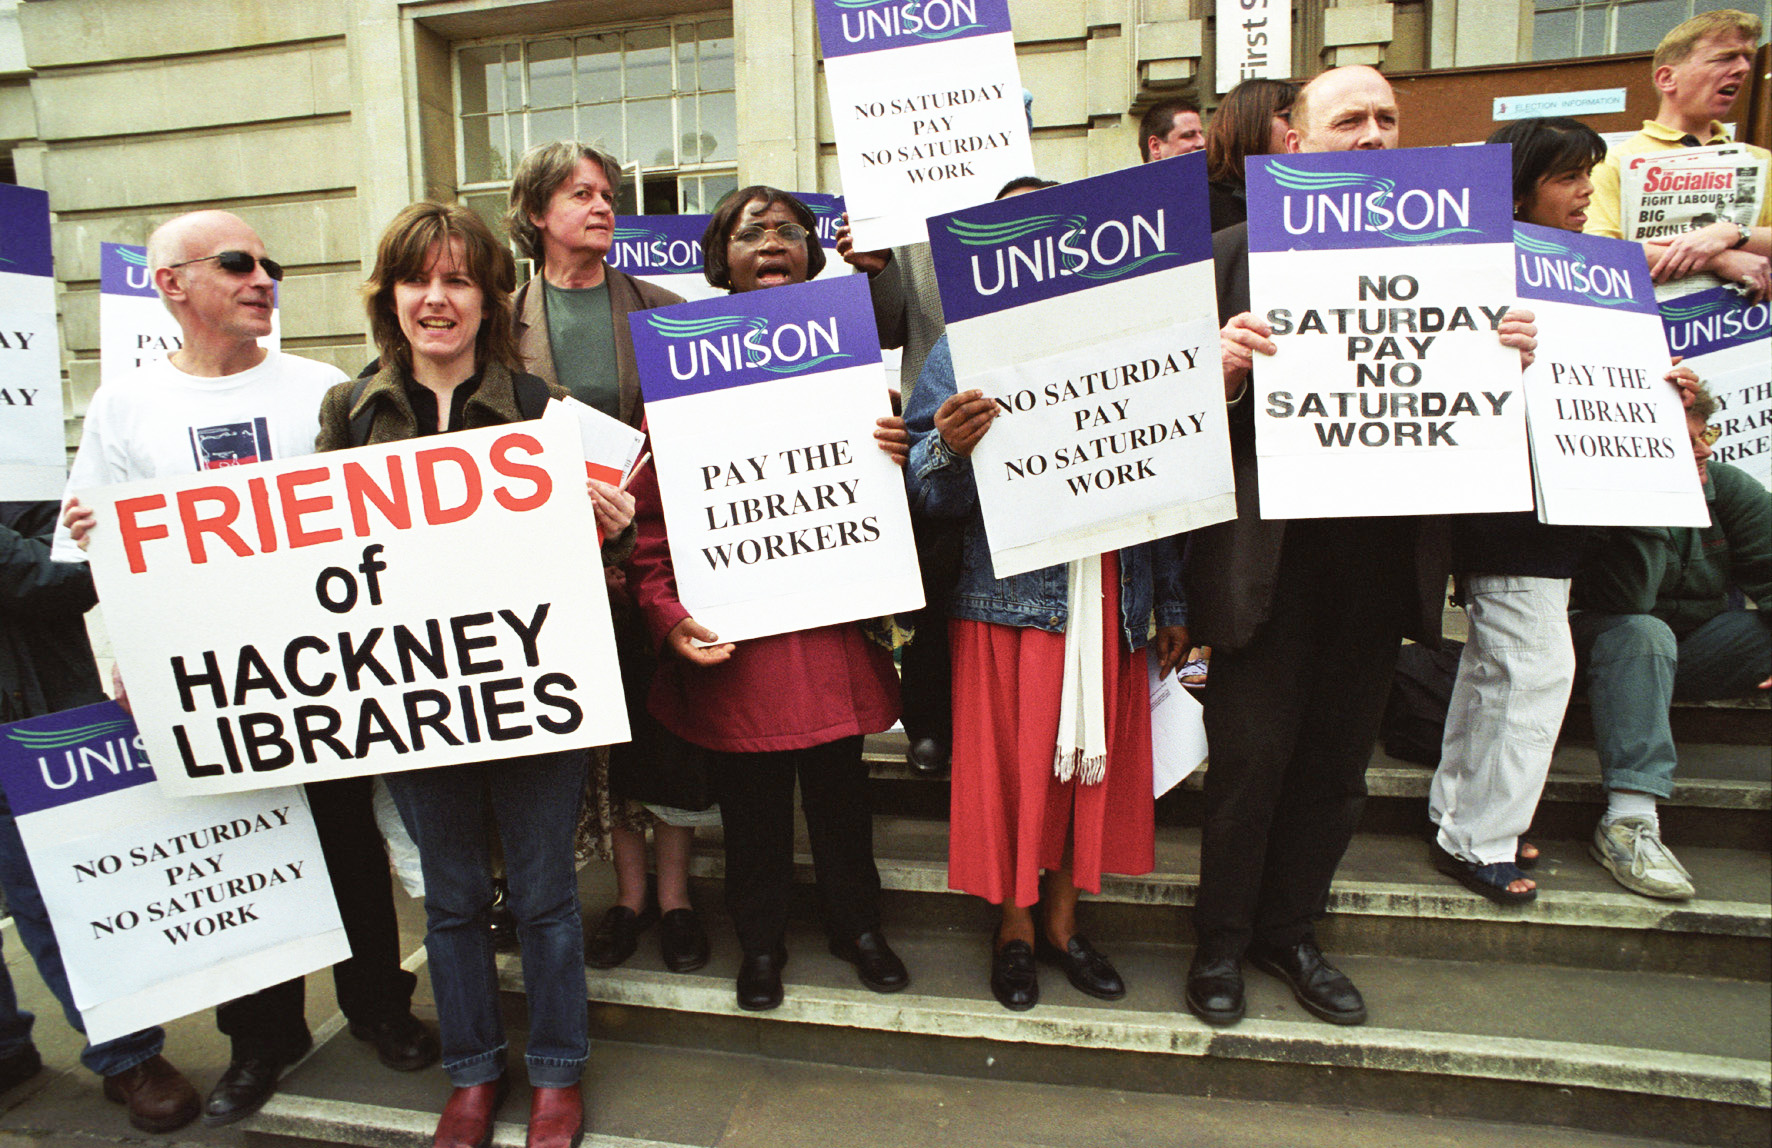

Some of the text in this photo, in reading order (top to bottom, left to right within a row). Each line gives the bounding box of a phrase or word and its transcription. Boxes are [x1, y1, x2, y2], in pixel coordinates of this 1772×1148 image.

[841, 0, 978, 43] UNISON
[855, 83, 1005, 120] NO SATURDAY
[1515, 97, 1620, 112] ELECTION INFORMATION
[912, 115, 954, 137] PAY
[861, 131, 1012, 168] NO SATURDAY
[906, 161, 975, 184] WORK
[1643, 166, 1733, 192] Socialist
[1283, 187, 1470, 236] UNISON
[1639, 209, 1665, 223] BIG
[1641, 193, 1735, 206] FIGHT LABOUR'S
[971, 209, 1167, 297] UNISON
[1359, 275, 1419, 301] NO
[1522, 256, 1634, 300] UNISON
[1267, 305, 1511, 335] SATURDAY
[1670, 303, 1770, 350] UNISO
[668, 317, 840, 380] UNISON
[1347, 337, 1436, 361] PAY
[995, 347, 1202, 417] NO SATURDAY
[1356, 363, 1422, 388] NO
[1552, 363, 1650, 390] PAY THE
[1739, 382, 1770, 405] TH
[1074, 399, 1131, 431] PAY
[1266, 391, 1513, 418] SATURDAY
[1556, 398, 1658, 424] LIBRARY
[1006, 413, 1208, 481] NO SATURDAY
[1315, 421, 1459, 447] WORK
[1556, 434, 1675, 459] WORKERS
[702, 440, 853, 490] PAY THE
[1067, 458, 1157, 496] WORK
[115, 433, 553, 574] FRIENDS
[704, 479, 860, 531] LIBRARY
[702, 517, 881, 571] WORKERS
[316, 544, 387, 613] of
[170, 602, 551, 712] HACKNEY
[172, 672, 584, 778] LIBRARIES
[73, 806, 291, 883] NO SATURDAY
[165, 855, 224, 886] PAY
[91, 861, 305, 939] NO SATURDAY
[164, 903, 260, 946] WORK
